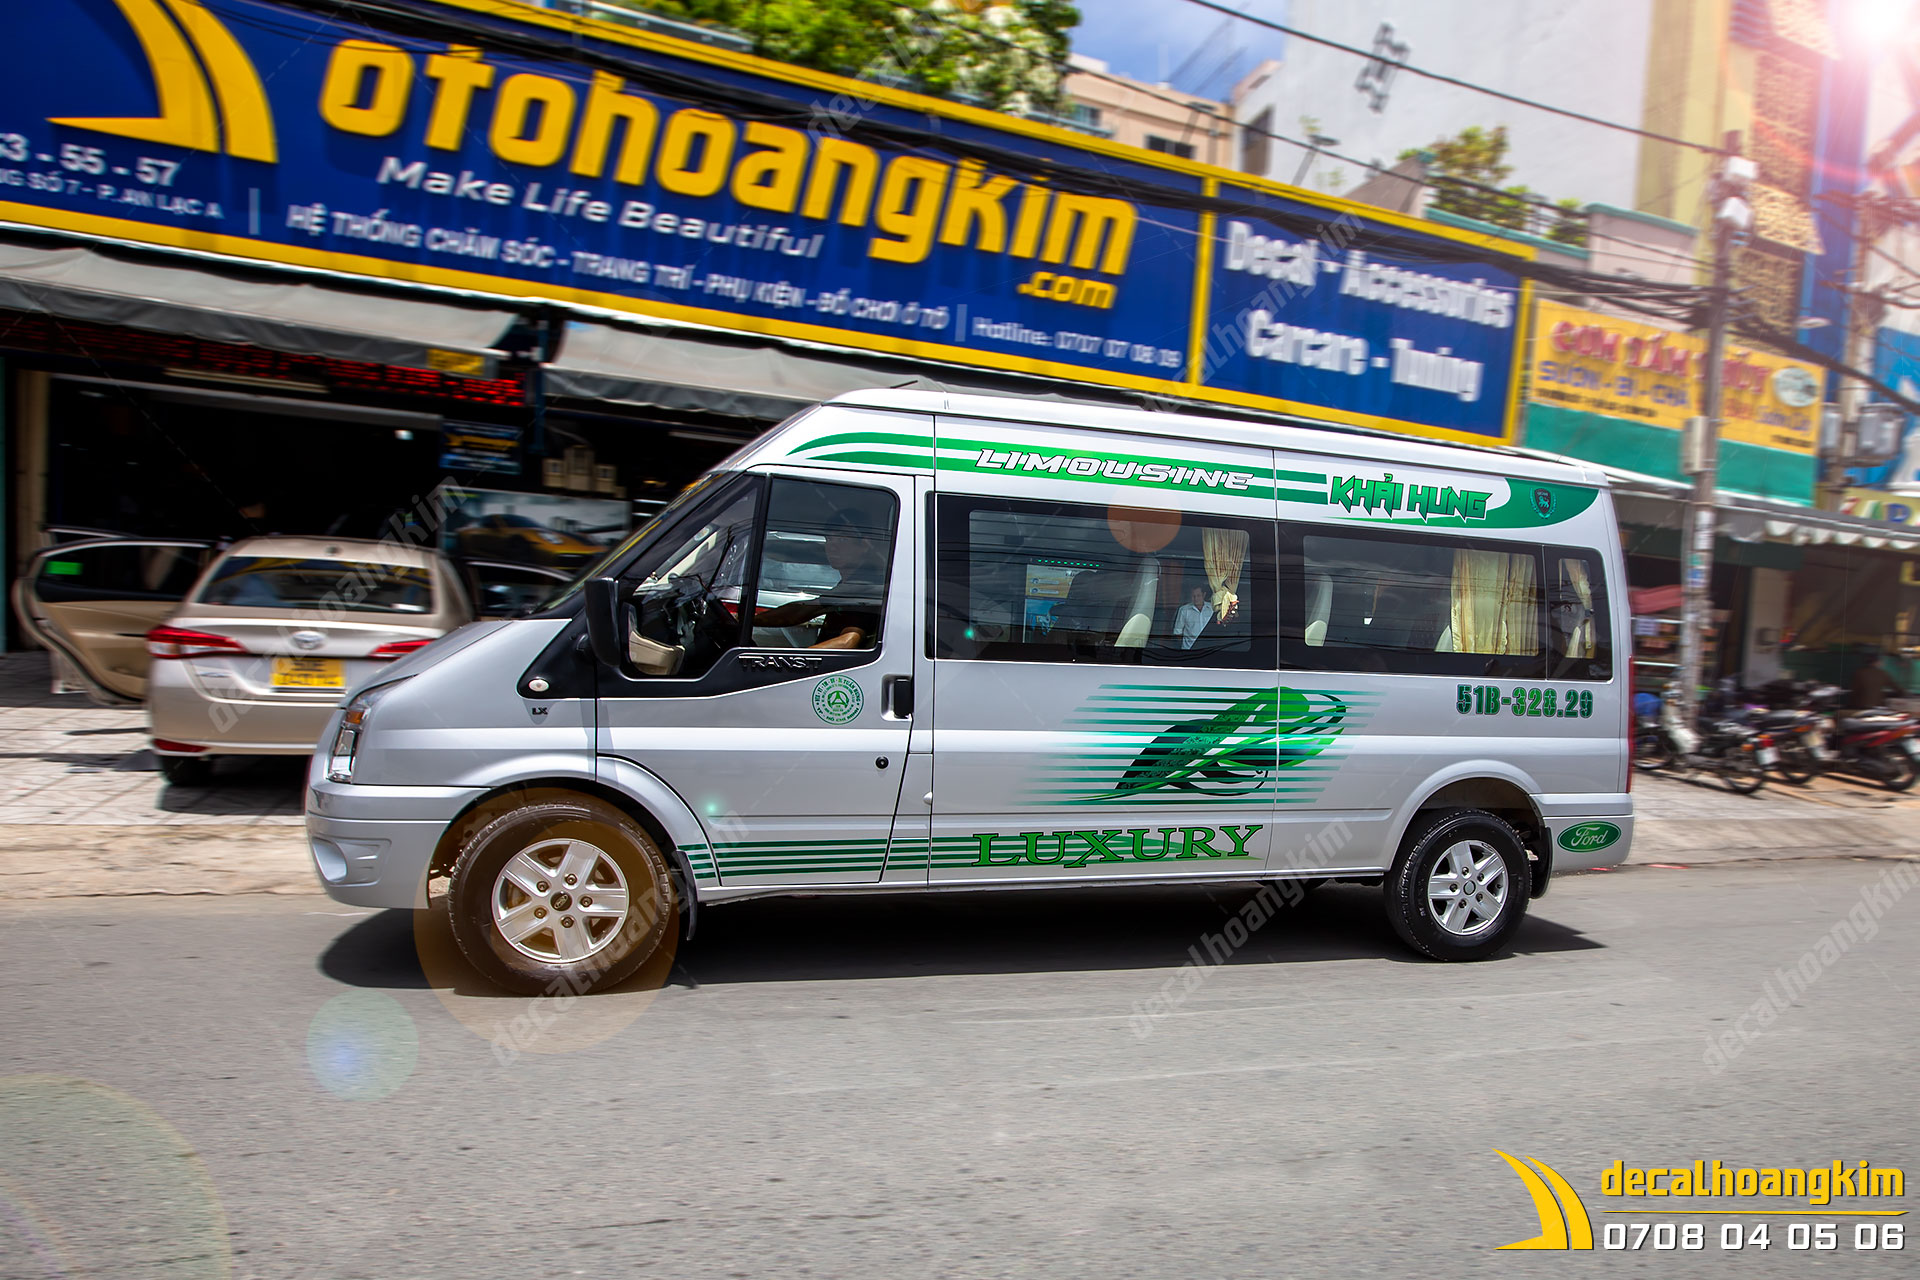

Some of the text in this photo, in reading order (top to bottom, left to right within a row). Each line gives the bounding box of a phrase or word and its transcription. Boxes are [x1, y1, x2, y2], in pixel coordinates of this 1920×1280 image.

[59, 143, 107, 175] 55
[135, 157, 181, 186] 57
[376, 156, 825, 259] Make Life Beautiful
[285, 202, 328, 237] HỆ
[330, 208, 423, 248] THỐNG
[501, 236, 557, 268] SÓC
[974, 448, 1255, 491] LIMOUSINE
[1329, 473, 1493, 523] KHẢI HƯNG
[1456, 684, 1594, 719] 51B-328.29
[971, 824, 1263, 868] LUXURY
[1570, 823, 1609, 847] Ford
